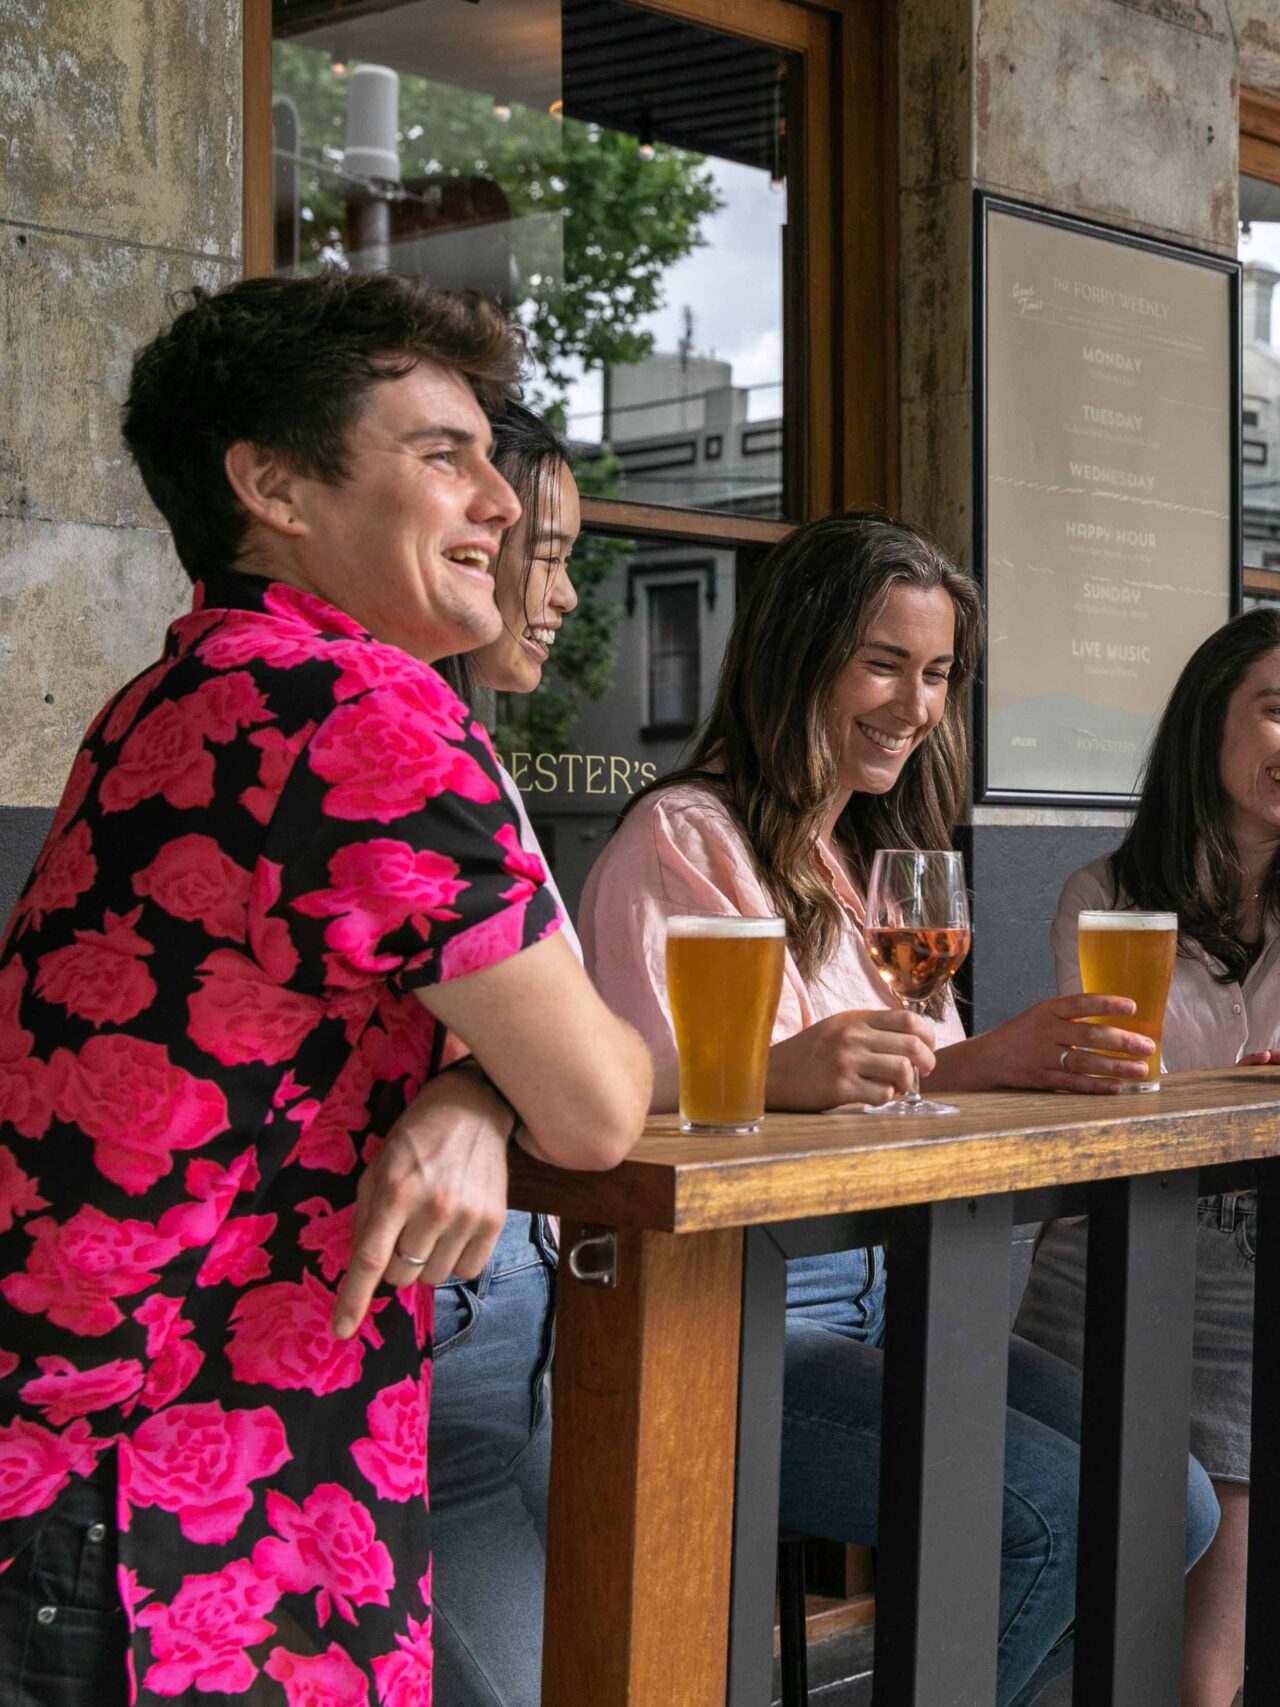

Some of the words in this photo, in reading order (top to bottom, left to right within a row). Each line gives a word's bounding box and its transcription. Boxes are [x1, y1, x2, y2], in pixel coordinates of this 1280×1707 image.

[1052, 277, 1070, 291] THE
[1073, 281, 1118, 306] FORRY
[1119, 294, 1169, 318] WEEKLY
[1083, 347, 1143, 372] MONDAY
[1082, 405, 1143, 430] TUESDAY
[1070, 462, 1155, 490] WEDNESDAY
[1066, 521, 1111, 541] HAPPY
[1117, 529, 1156, 549] HOUR
[1083, 583, 1141, 603] SUNDAY
[1072, 639, 1101, 659] LIVE
[1107, 644, 1150, 663] MUSIC
[496, 752, 657, 794] ESTER'S
